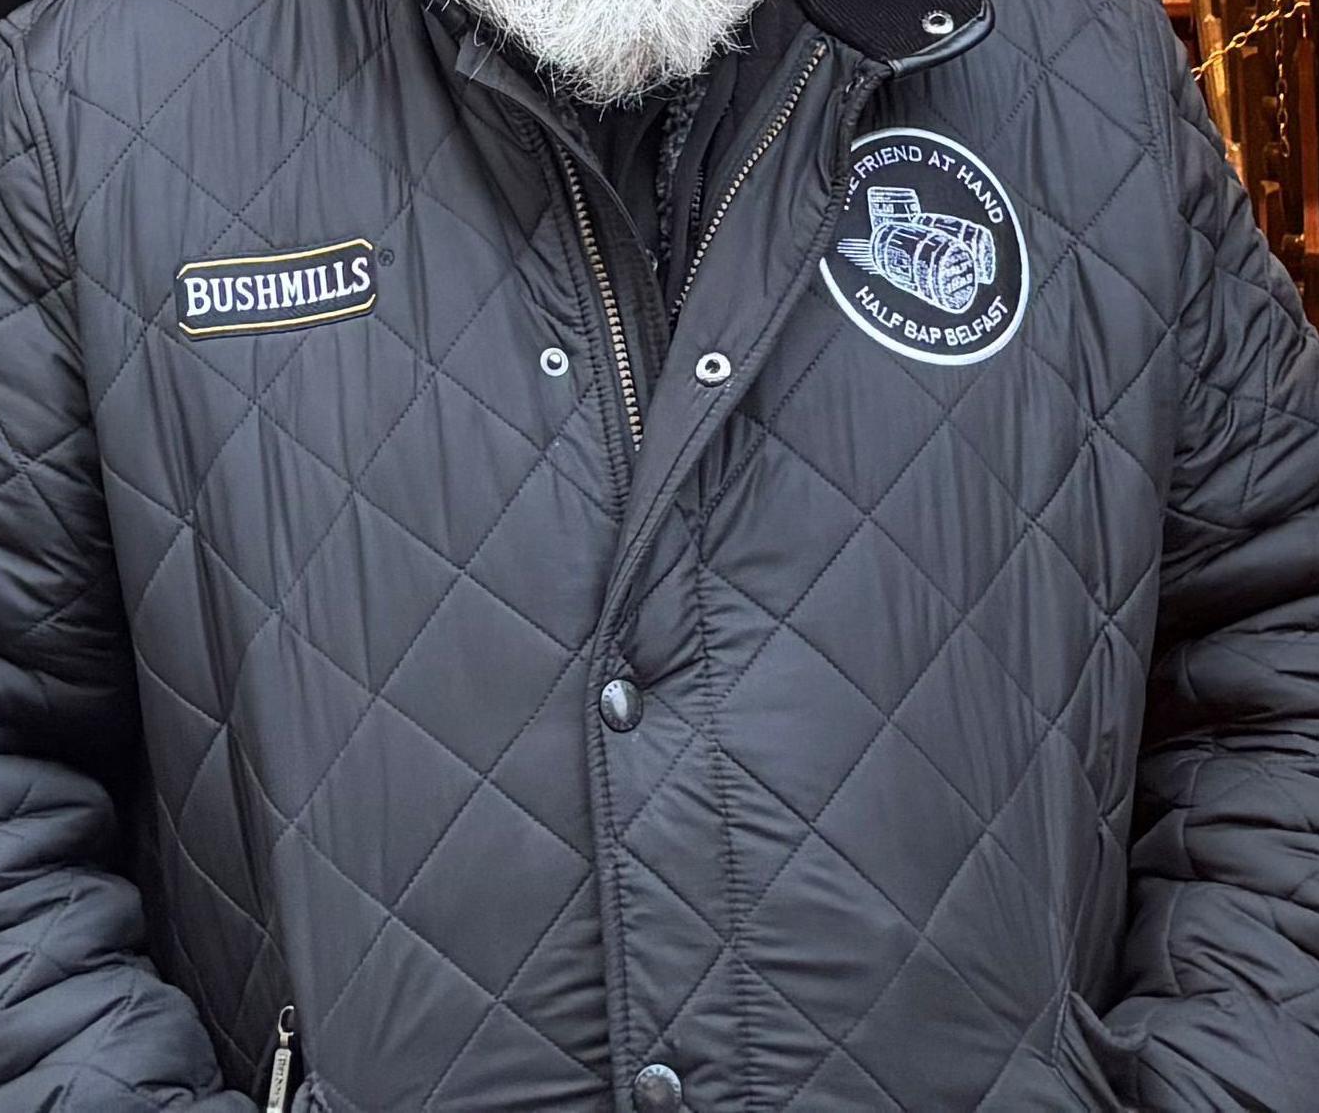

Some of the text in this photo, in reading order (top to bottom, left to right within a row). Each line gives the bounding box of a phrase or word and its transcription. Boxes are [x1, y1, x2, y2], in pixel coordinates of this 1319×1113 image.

[853, 145, 1004, 224] FRIEND AT HAND
[183, 257, 371, 317] BUSHMILLS
[855, 286, 1009, 347] HALF BAP BELFAST
